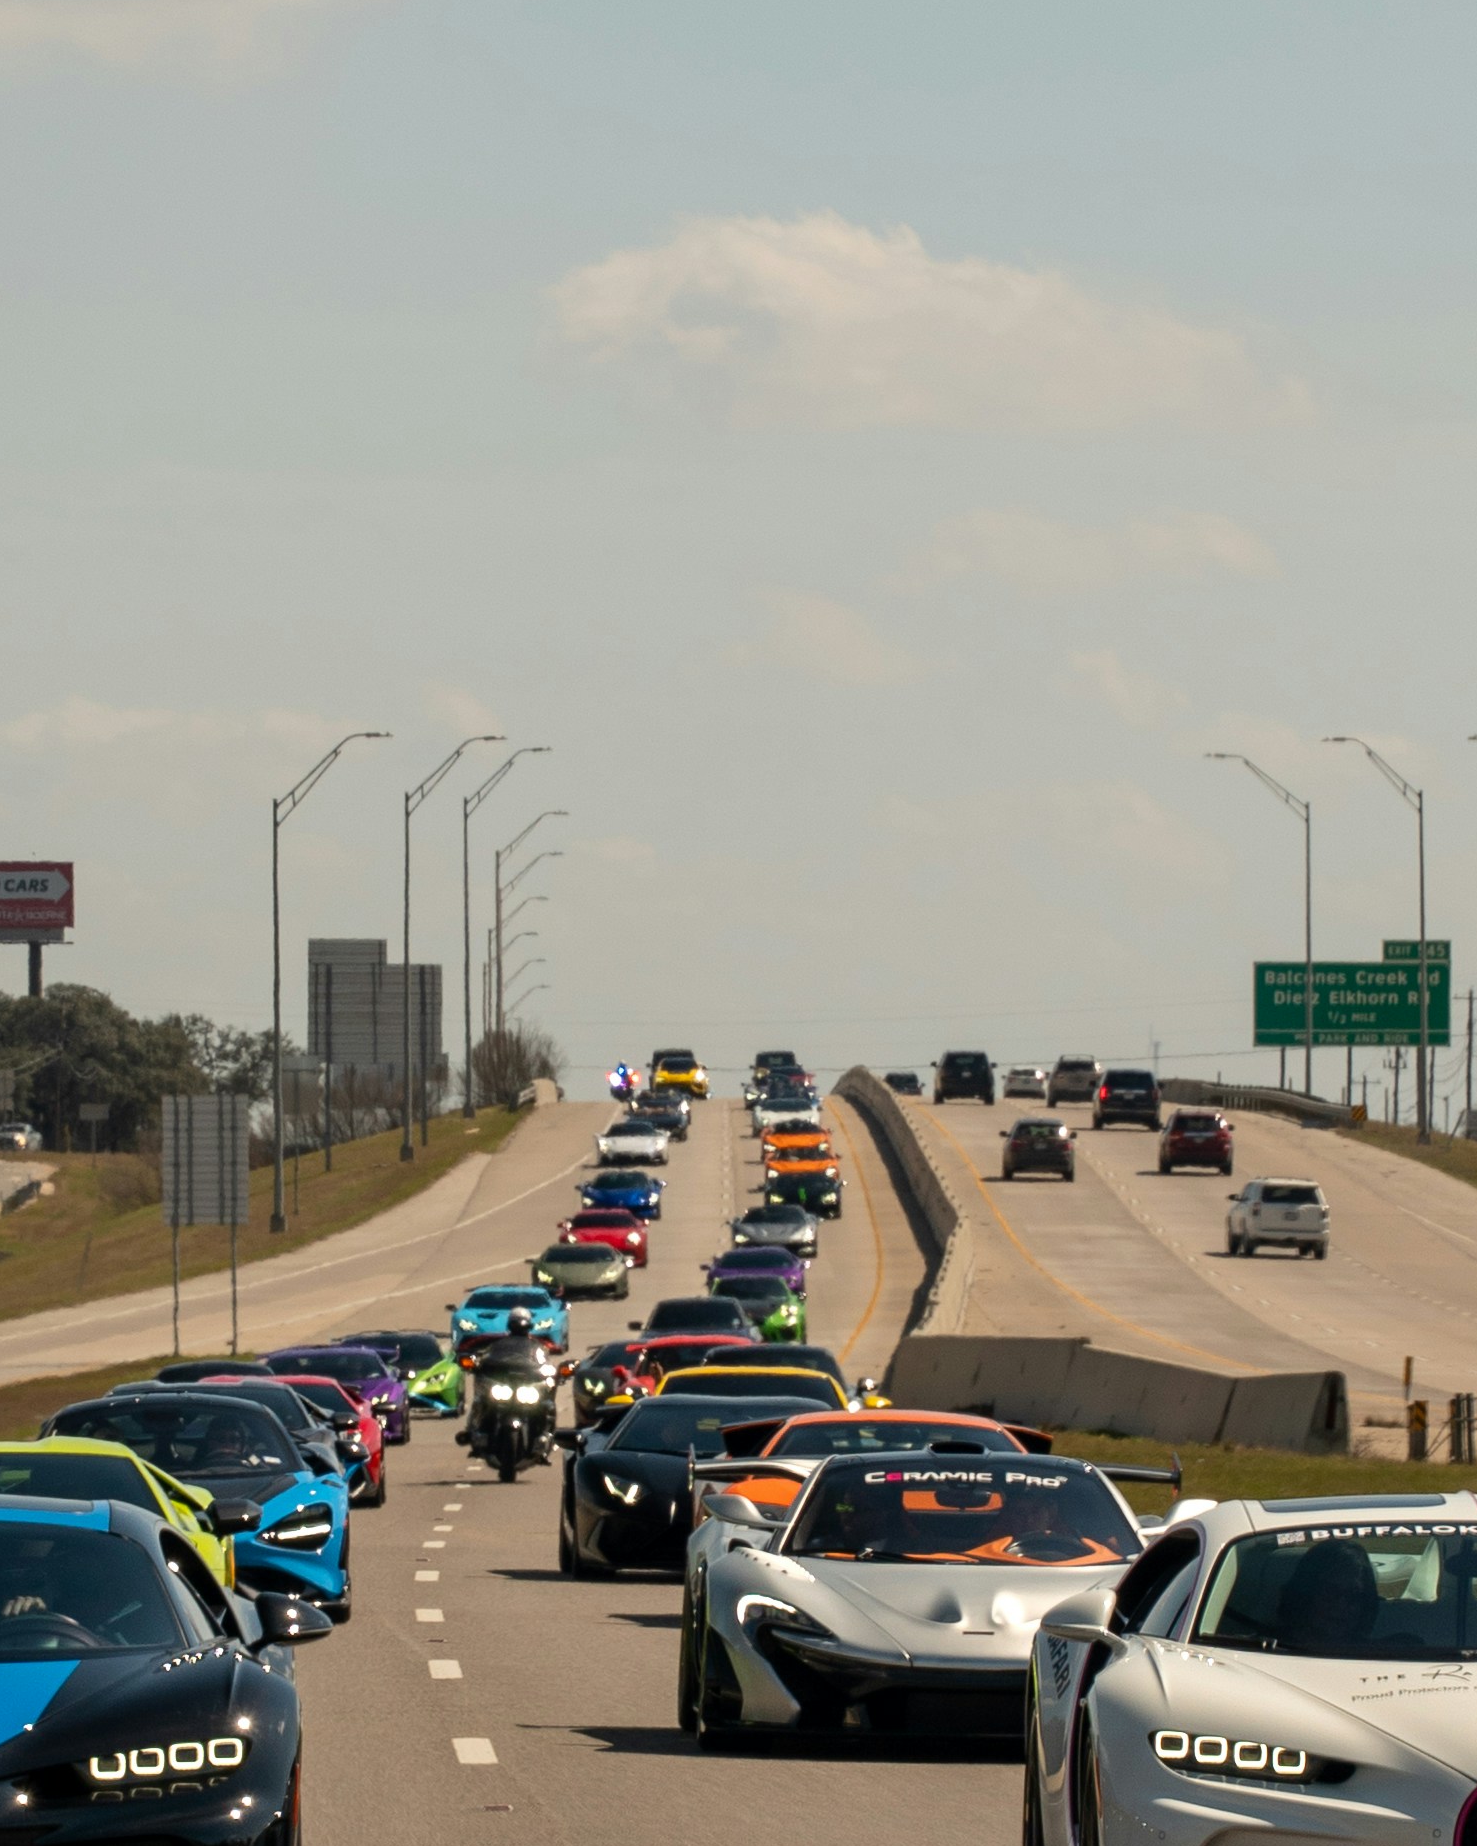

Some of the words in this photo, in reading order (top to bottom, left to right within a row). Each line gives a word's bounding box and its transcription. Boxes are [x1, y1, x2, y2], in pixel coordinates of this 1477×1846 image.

[4, 878, 49, 893] CARS
[1388, 945, 1411, 955] EXIT
[1355, 970, 1408, 985] Creek
[1329, 990, 1399, 1005] Elkhorn
[1351, 1012, 1377, 1023] MILE
[1319, 1033, 1348, 1043] PARK
[1354, 1033, 1379, 1043] AND
[1383, 1033, 1409, 1043] RIDE
[1360, 1673, 1406, 1683] THE
[1351, 1690, 1394, 1702] Proud
[1398, 1685, 1469, 1697] Protectors
